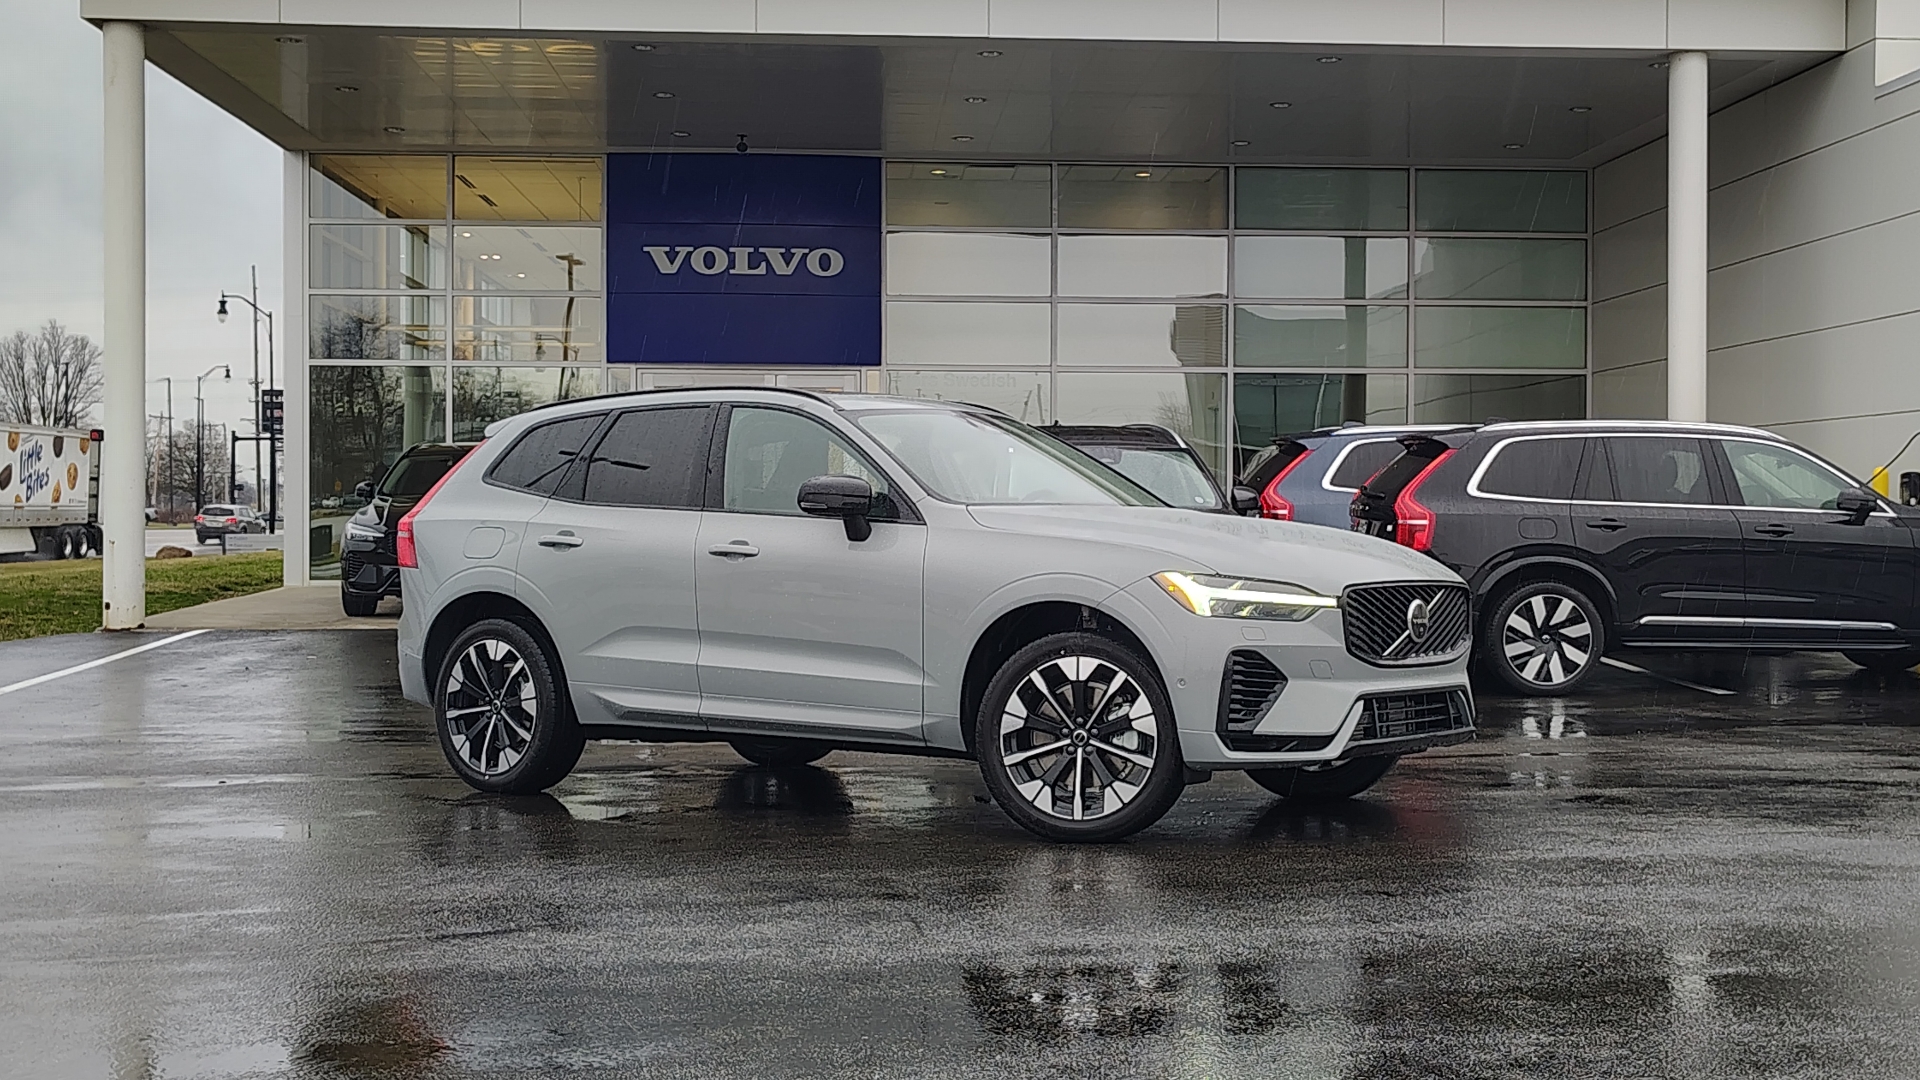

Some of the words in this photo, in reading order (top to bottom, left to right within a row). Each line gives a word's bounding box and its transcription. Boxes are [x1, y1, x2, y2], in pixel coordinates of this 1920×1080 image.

[643, 246, 844, 277] VOLVO
[943, 372, 1017, 388] Swedish
[19, 439, 43, 485] Little
[25, 467, 50, 503] Bites
